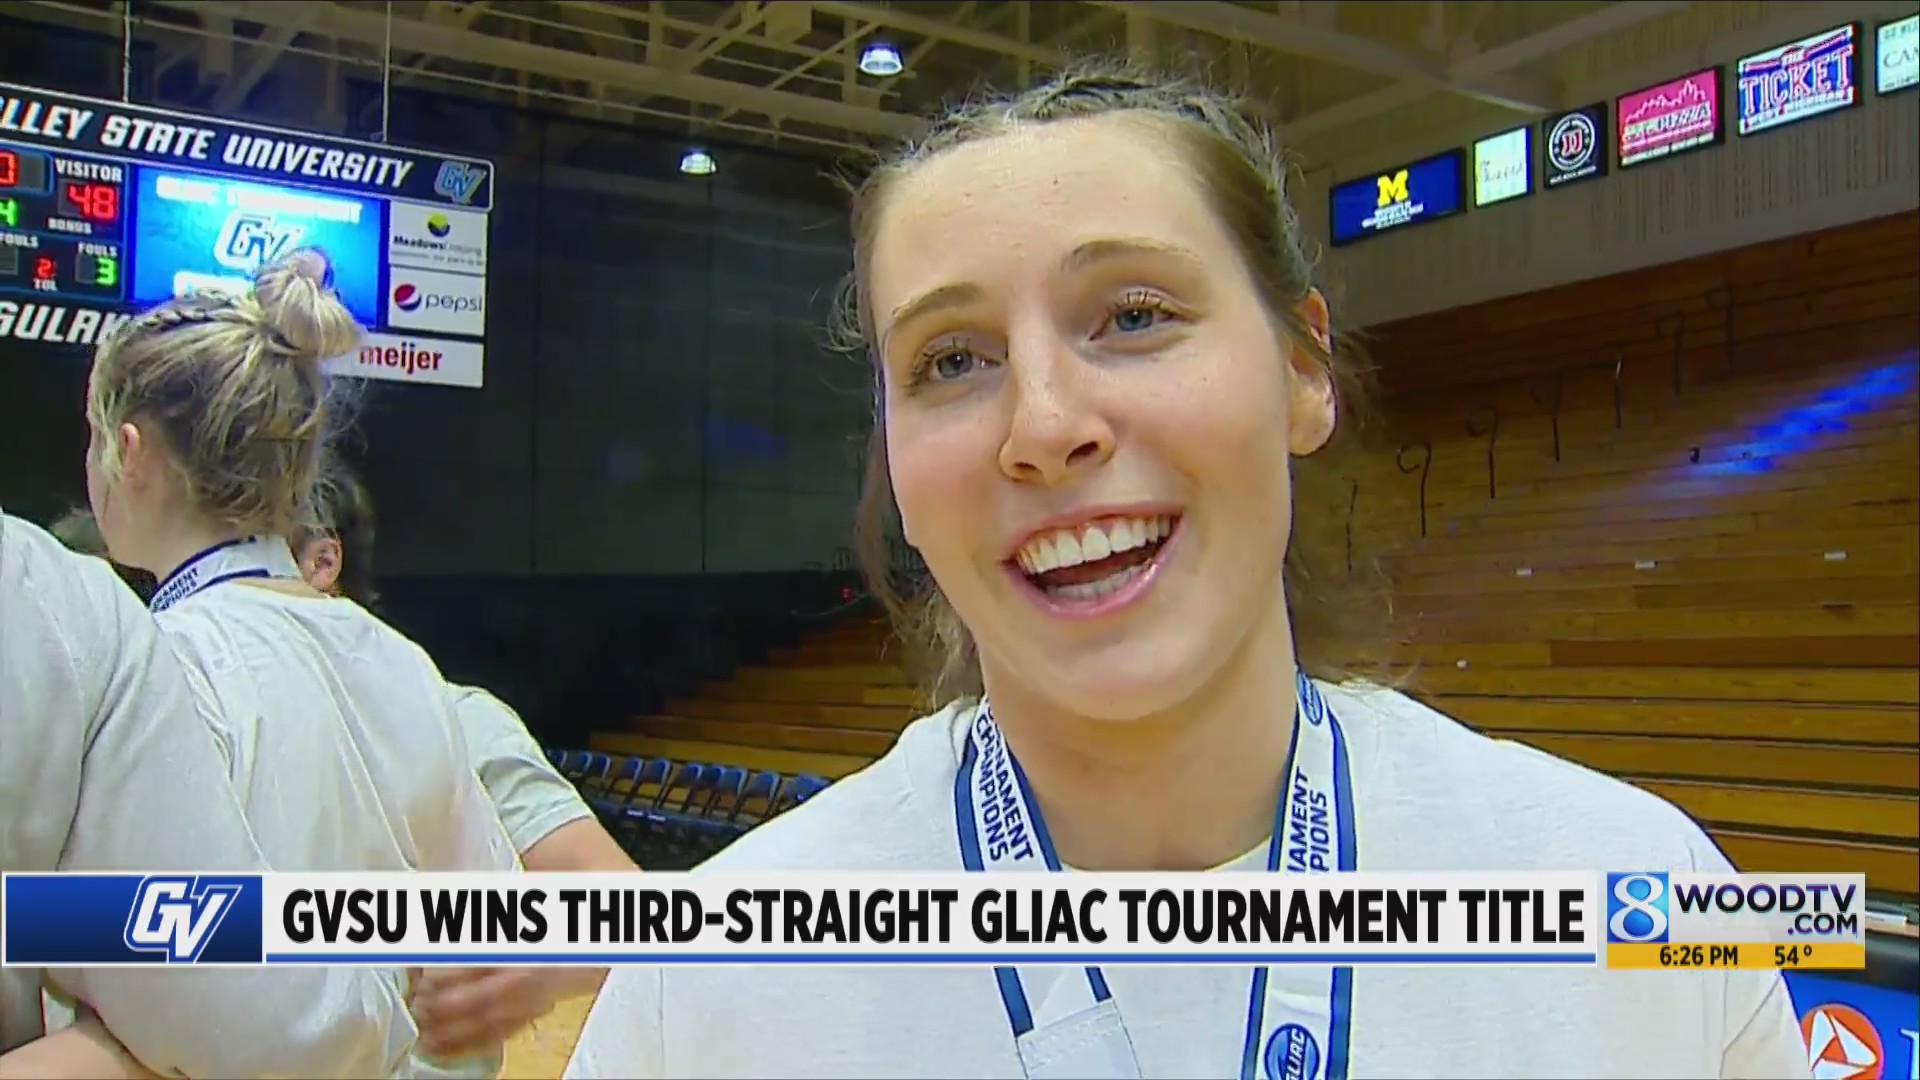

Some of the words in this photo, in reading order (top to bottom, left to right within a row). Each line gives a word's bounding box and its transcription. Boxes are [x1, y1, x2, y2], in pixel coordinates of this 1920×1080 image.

[1739, 43, 1853, 117] TICKET
[0, 96, 94, 140] LLEY
[101, 115, 214, 160] STATE
[222, 134, 414, 188] UNIVERSITY
[55, 158, 123, 183] VISITOR
[434, 160, 487, 205] GV
[68, 183, 116, 220] 48
[1377, 169, 1409, 208] M
[0, 231, 39, 249] FOULS
[48, 217, 92, 235] BONUS
[78, 242, 118, 257] FOULS
[37, 257, 54, 279] 2
[96, 256, 117, 286] 3
[33, 278, 58, 292] TOL
[425, 292, 483, 314] pepsi
[359, 342, 443, 375] meijer
[976, 714, 1008, 862] CHAMPIONS
[1287, 766, 1308, 872] AMENT
